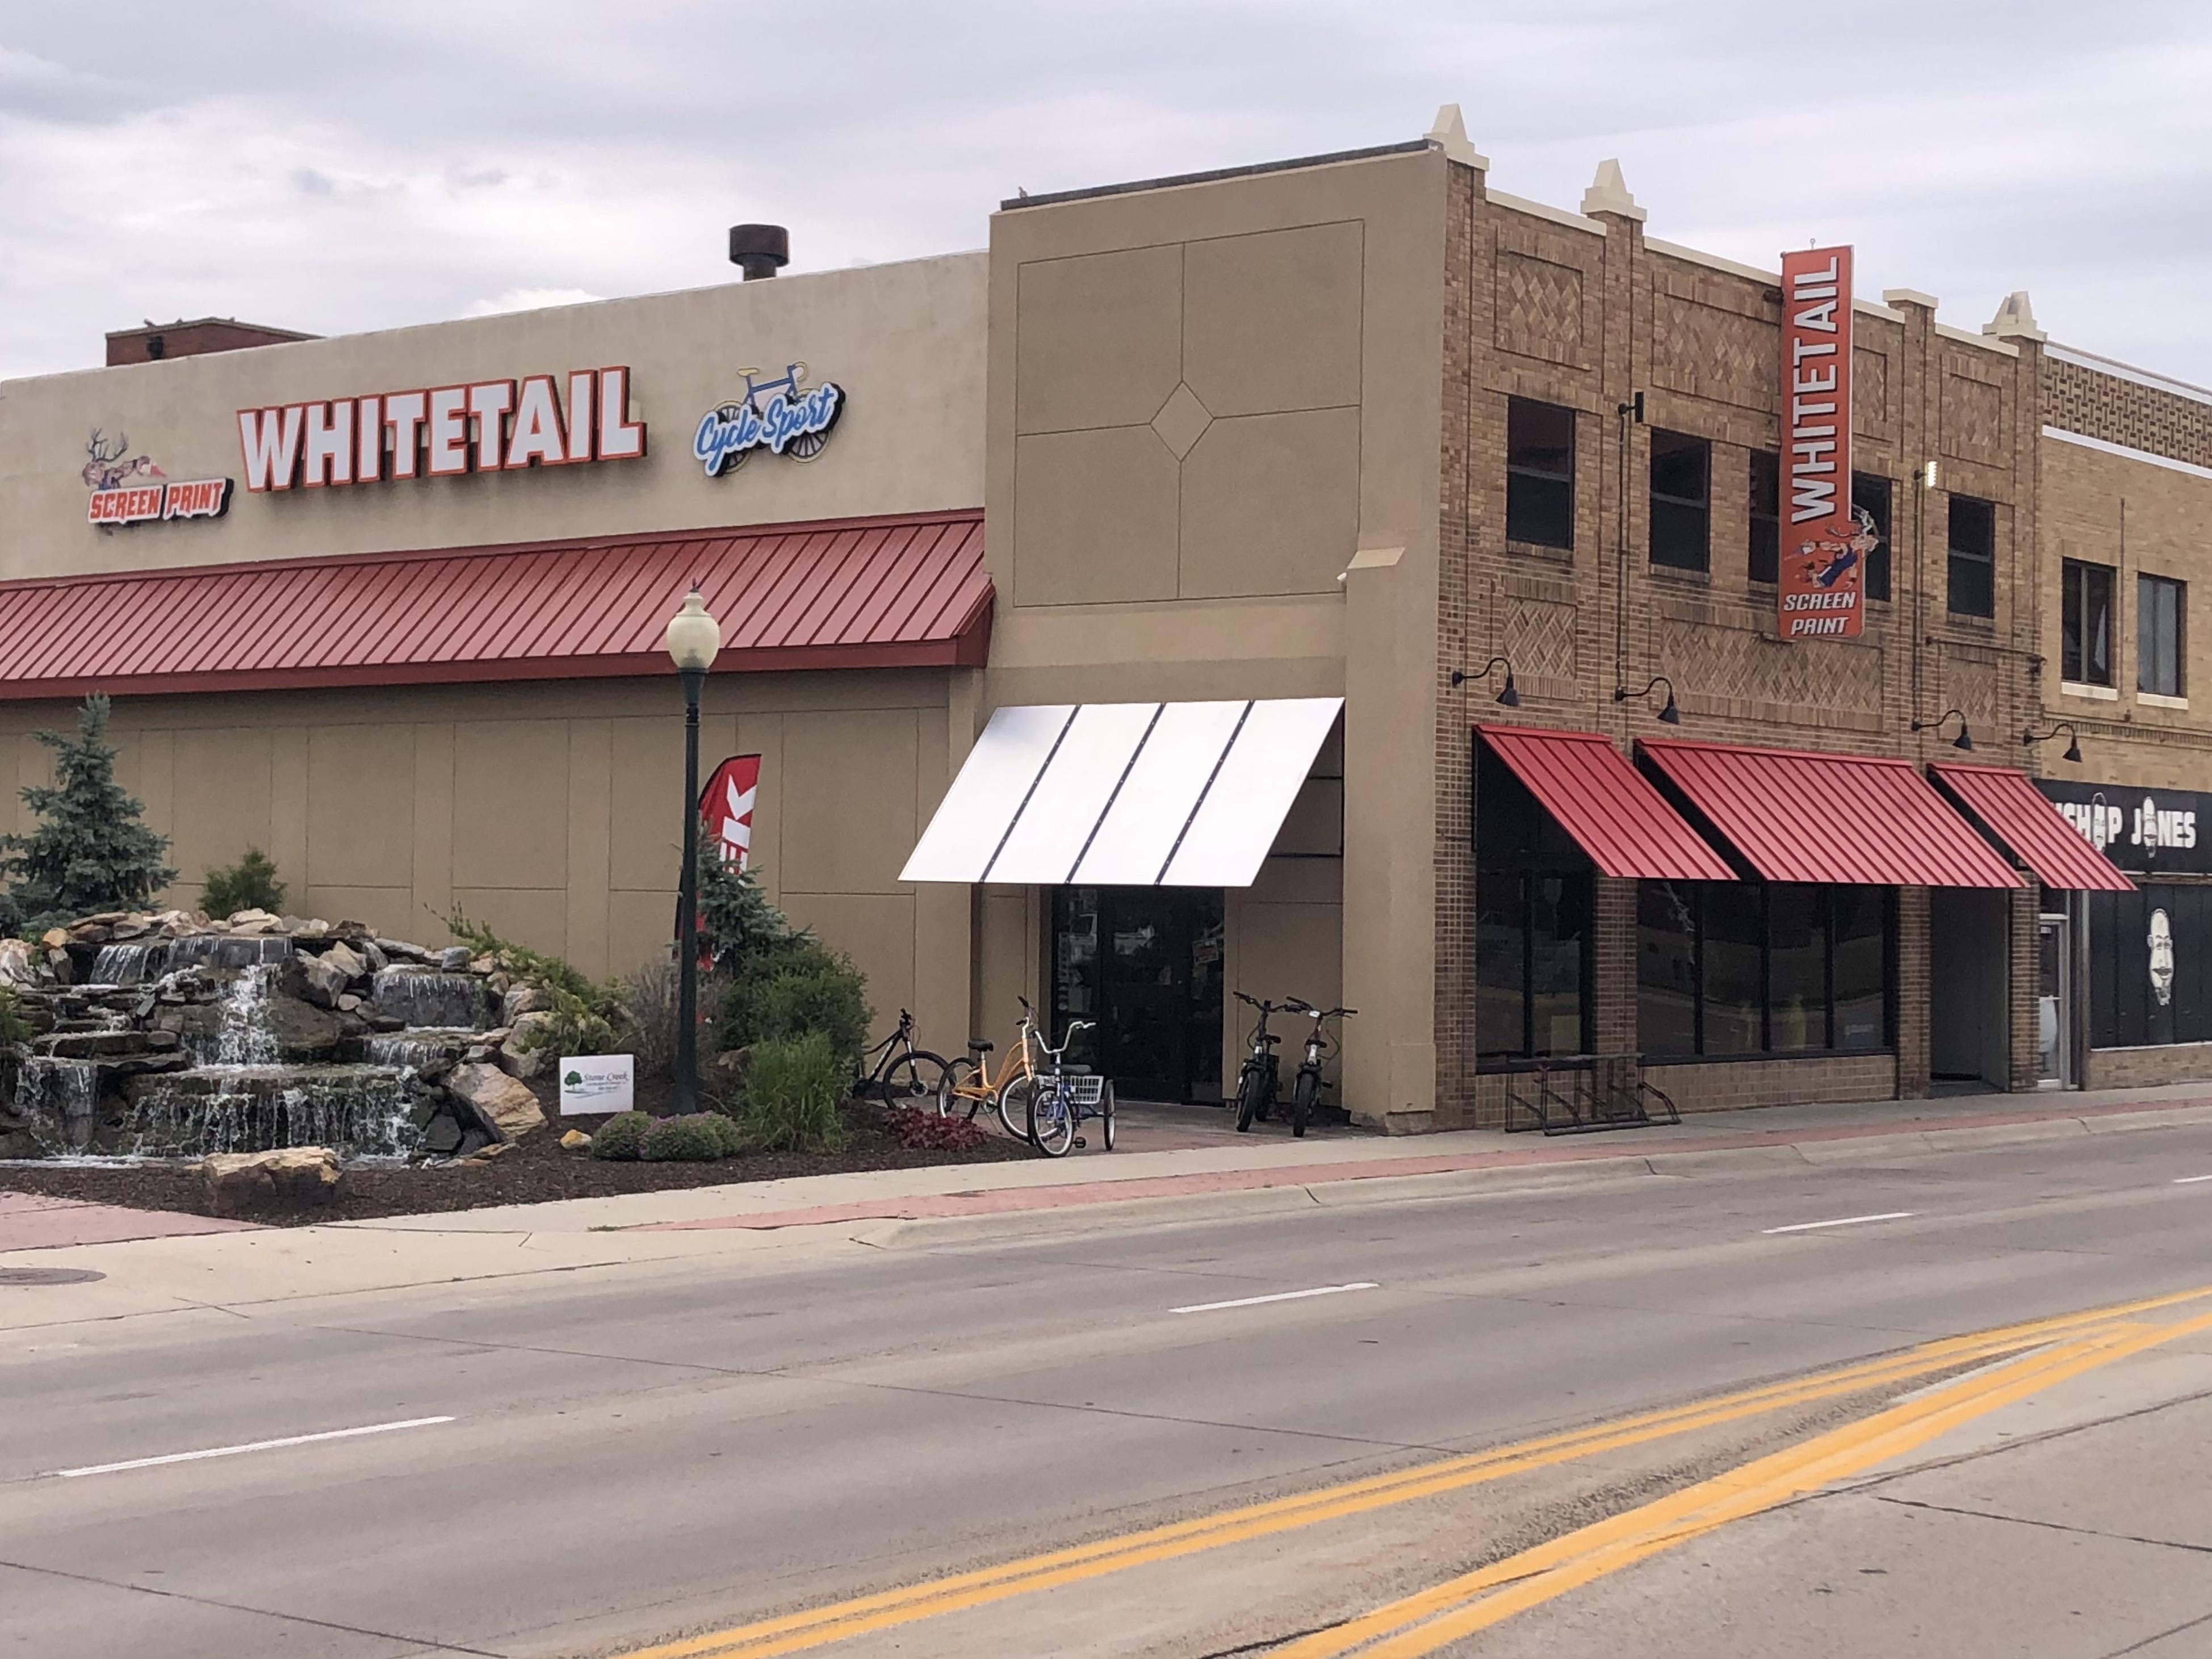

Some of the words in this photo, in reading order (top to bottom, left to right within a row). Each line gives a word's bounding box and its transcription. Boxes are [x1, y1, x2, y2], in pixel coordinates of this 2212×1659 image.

[1791, 256, 1838, 523] WHITETAIL
[237, 366, 644, 492] WHITETAIL
[696, 408, 761, 472] Cycle
[761, 387, 835, 449] Sport
[89, 488, 161, 519] SCREEN
[166, 482, 224, 514] PRINT
[1783, 592, 1856, 611] SCREEN
[1790, 617, 1850, 635] PRINT
[2131, 798, 2196, 854] JONES
